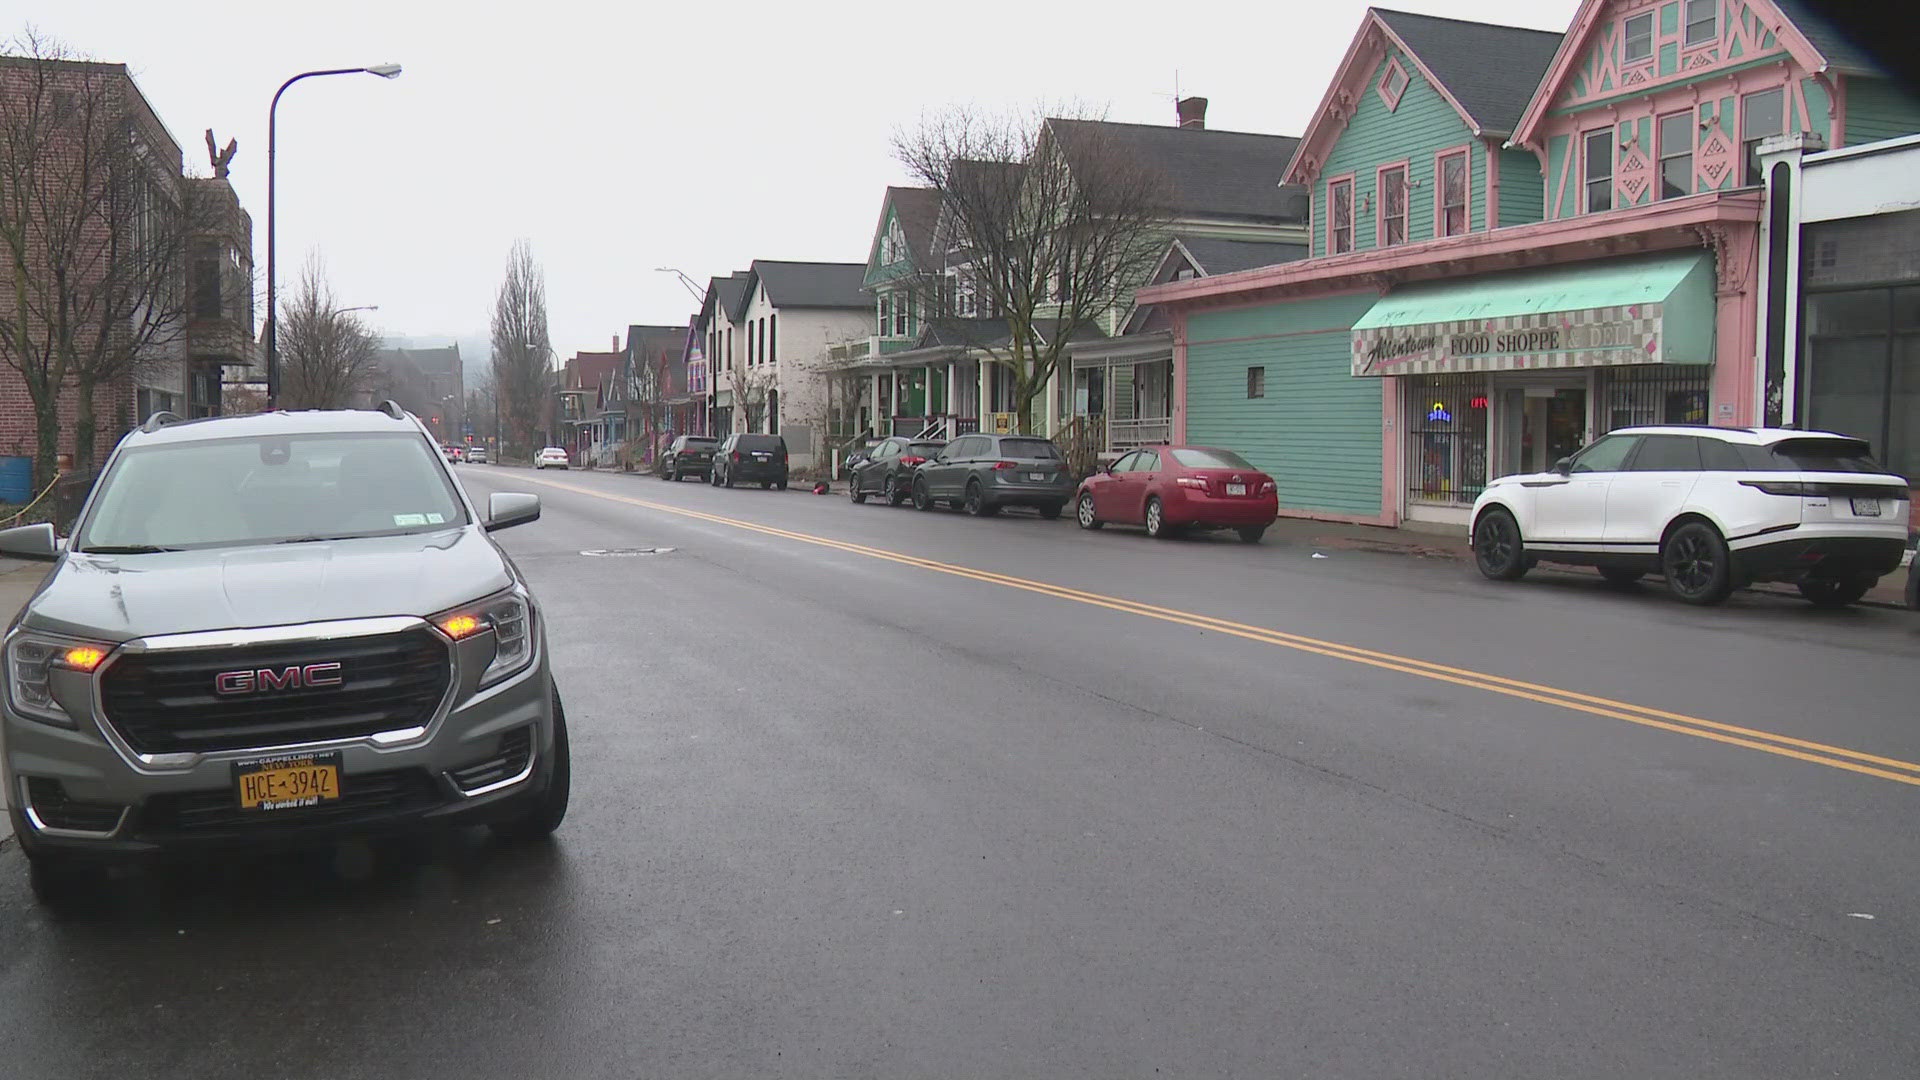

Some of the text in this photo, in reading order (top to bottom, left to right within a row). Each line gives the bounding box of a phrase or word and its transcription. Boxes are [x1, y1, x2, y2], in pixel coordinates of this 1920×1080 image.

[1363, 324, 1633, 374] Allentown FOOD SHOPPE & DELI
[215, 662, 342, 694] GMC
[262, 759, 314, 771] NEW YORK
